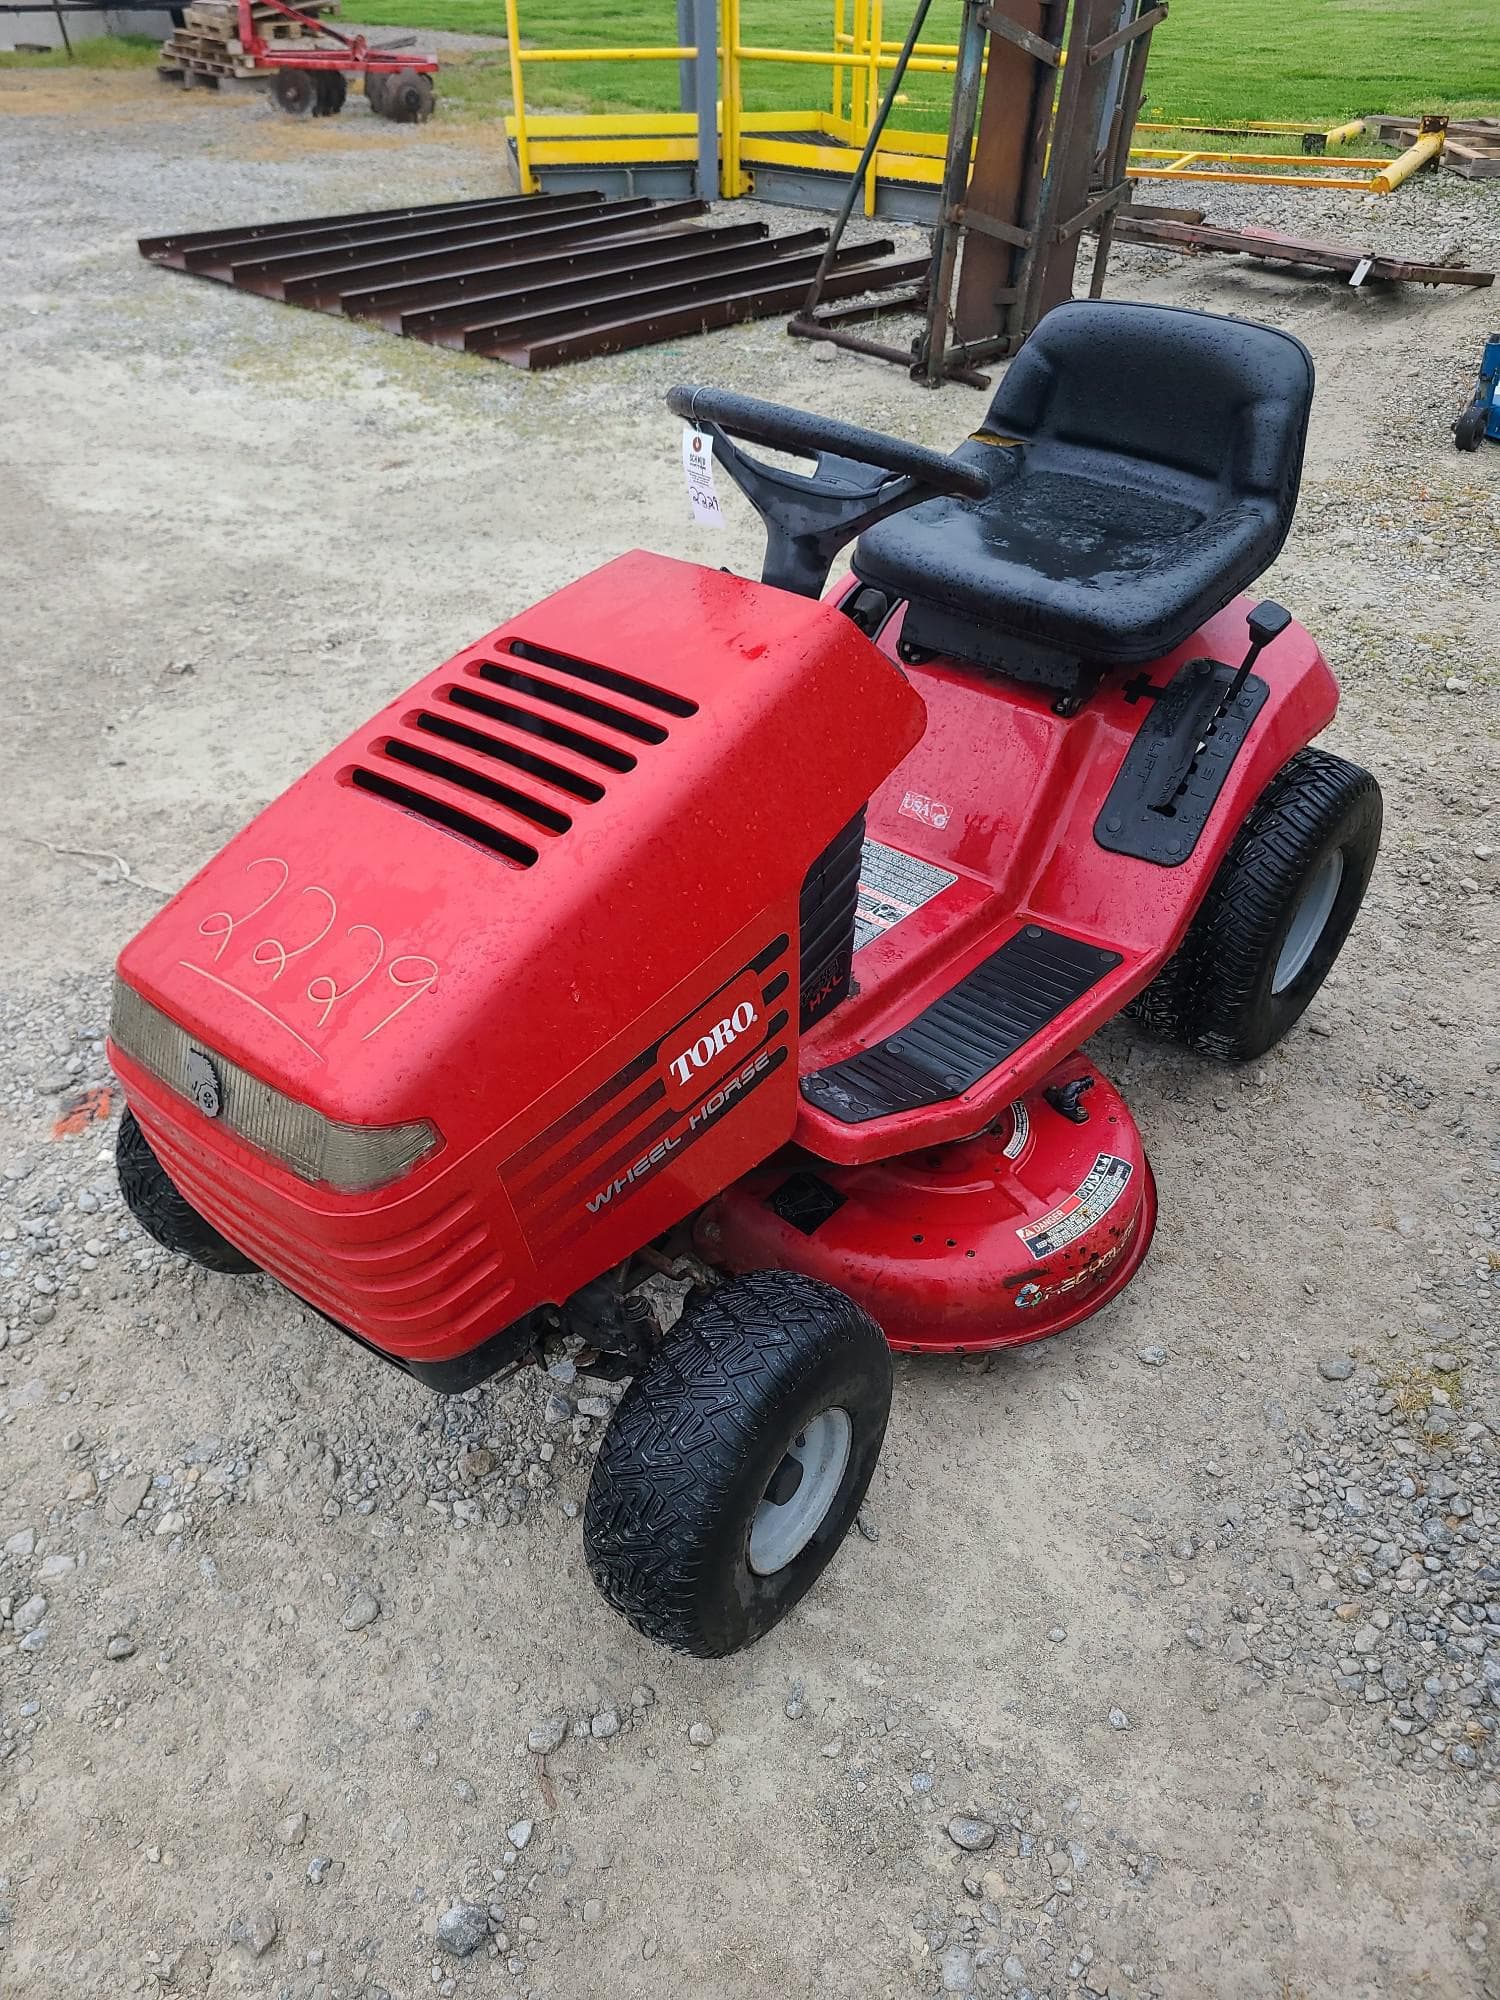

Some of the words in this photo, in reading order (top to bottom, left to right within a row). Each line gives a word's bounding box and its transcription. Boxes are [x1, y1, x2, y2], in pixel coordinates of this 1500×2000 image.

[902, 799, 929, 817] USA
[198, 857, 439, 1041] 2229
[669, 1001, 755, 1087] TORO
[585, 1136, 682, 1213] WHEEL
[689, 1051, 770, 1131] HORSE
[1032, 1209, 1066, 1232] DANGER
